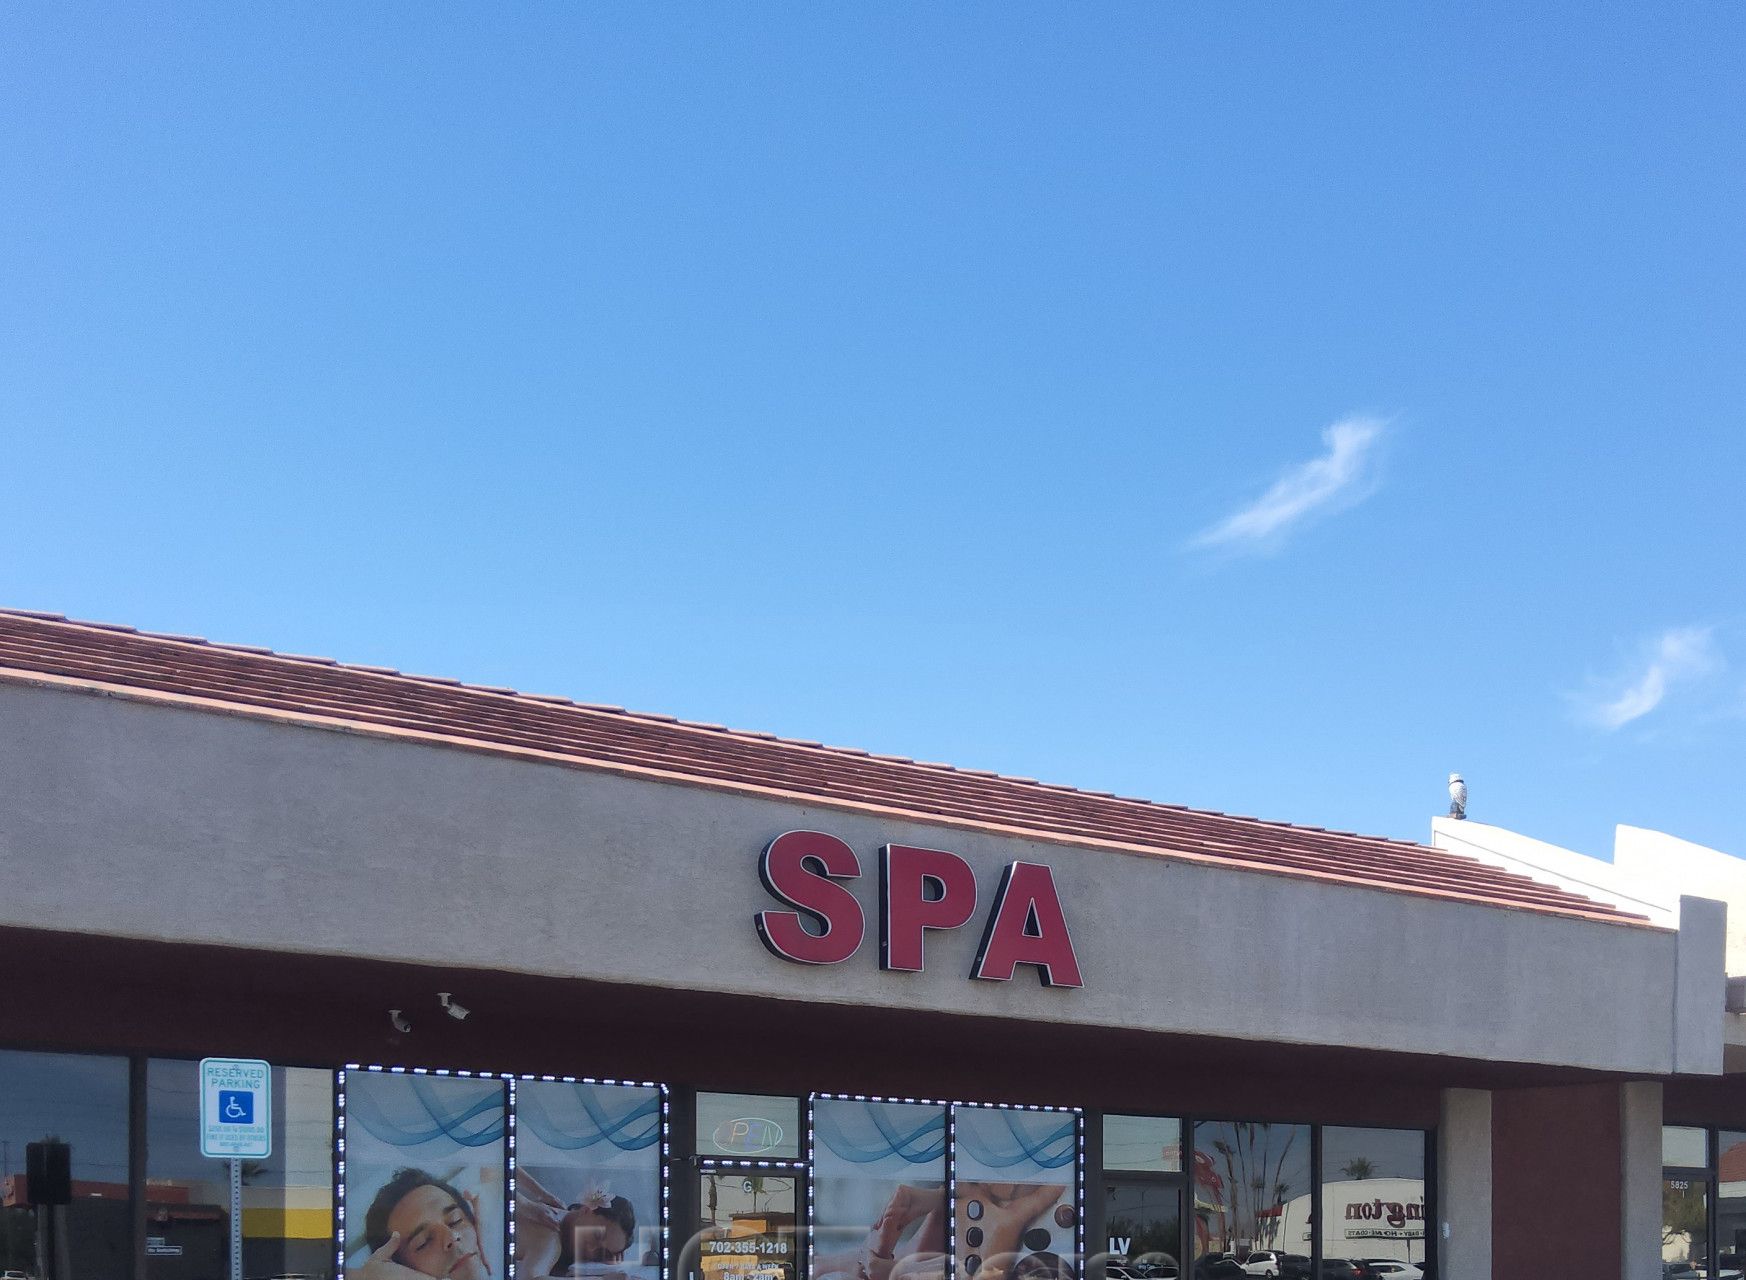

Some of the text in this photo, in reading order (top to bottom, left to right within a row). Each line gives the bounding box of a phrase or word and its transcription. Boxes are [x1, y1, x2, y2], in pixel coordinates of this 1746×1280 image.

[754, 829, 1085, 989] SPA
[207, 1067, 264, 1079] RESERVED
[211, 1078, 261, 1089] PARKING
[1109, 1237, 1131, 1255] LV
